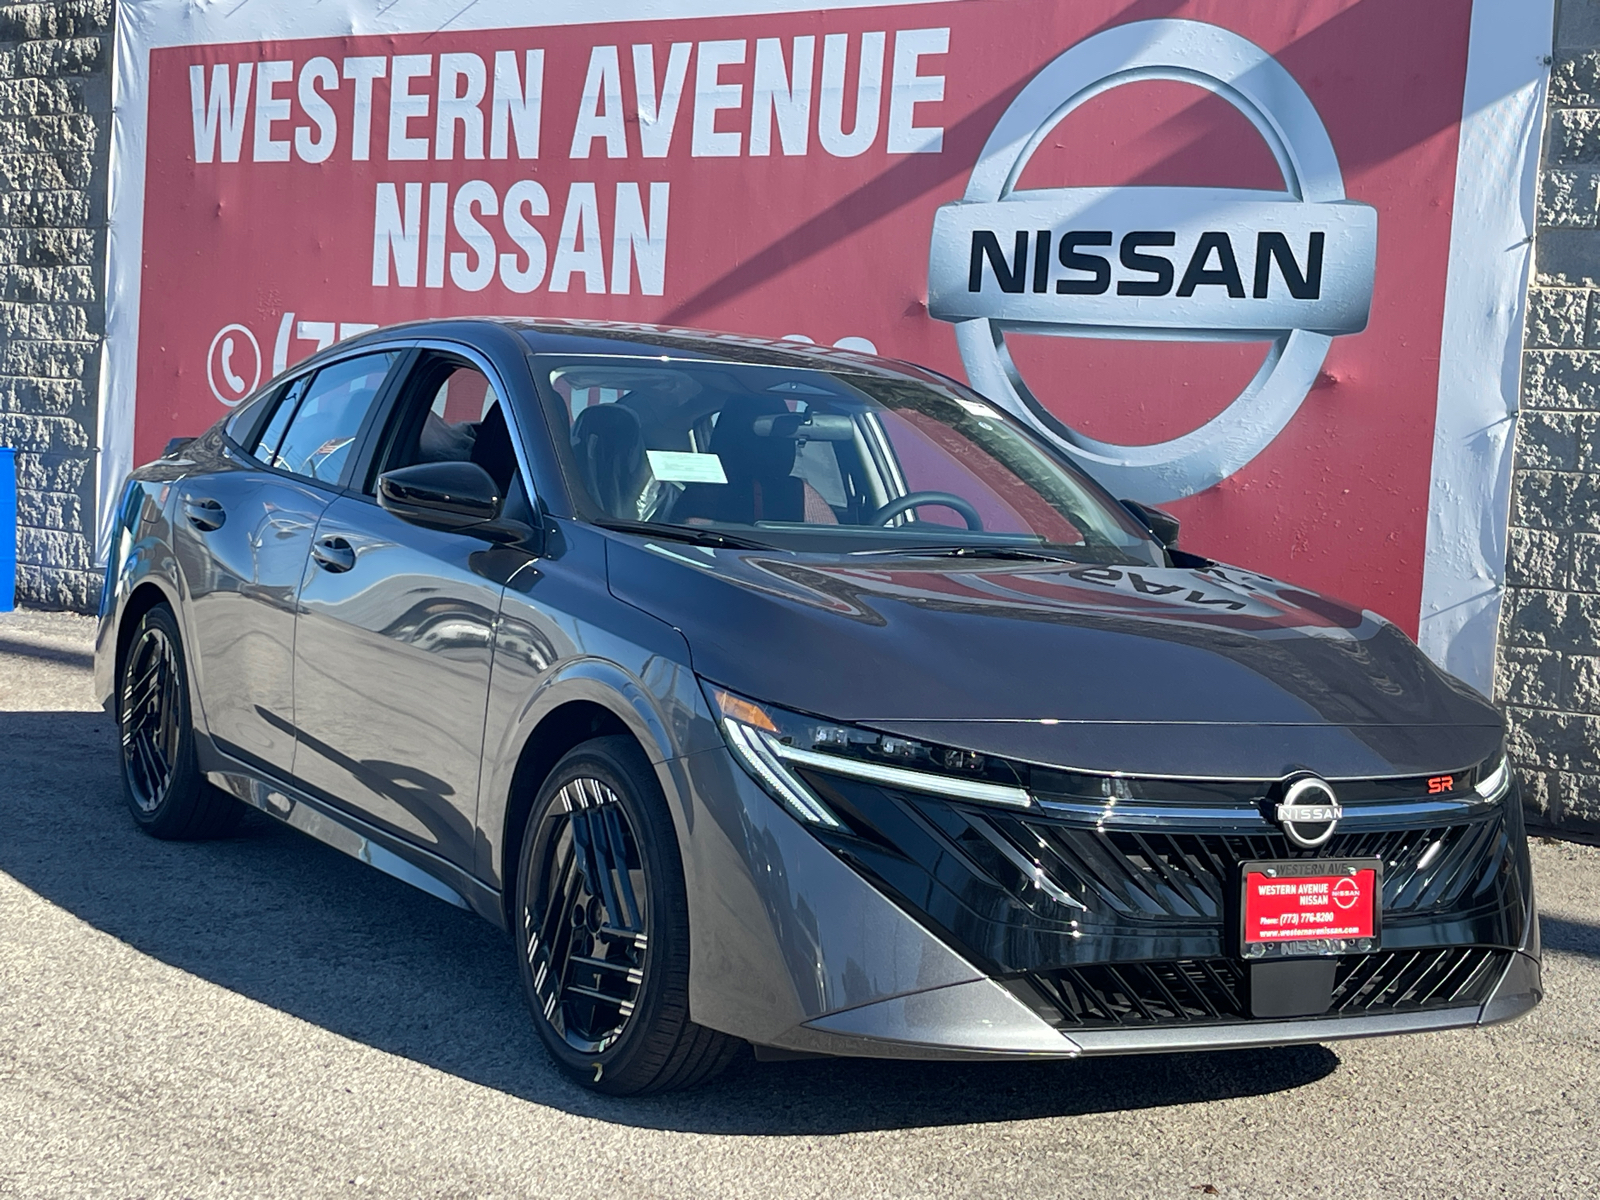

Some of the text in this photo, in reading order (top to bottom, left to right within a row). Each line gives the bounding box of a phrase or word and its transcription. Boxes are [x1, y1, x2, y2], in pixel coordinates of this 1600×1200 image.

[190, 27, 951, 164] WESTERN AVENUE
[371, 180, 670, 296] NISSAN
[968, 230, 1325, 300] NISSAN
[1428, 776, 1453, 794] SR
[1280, 807, 1343, 820] NISSAN
[1276, 864, 1325, 875] WESTERN
[1258, 883, 1329, 895] WESTERN AVENUE
[1300, 895, 1329, 906] NISSAN
[1280, 913, 1298, 925] (773)
[1281, 939, 1347, 955] NISSAN
